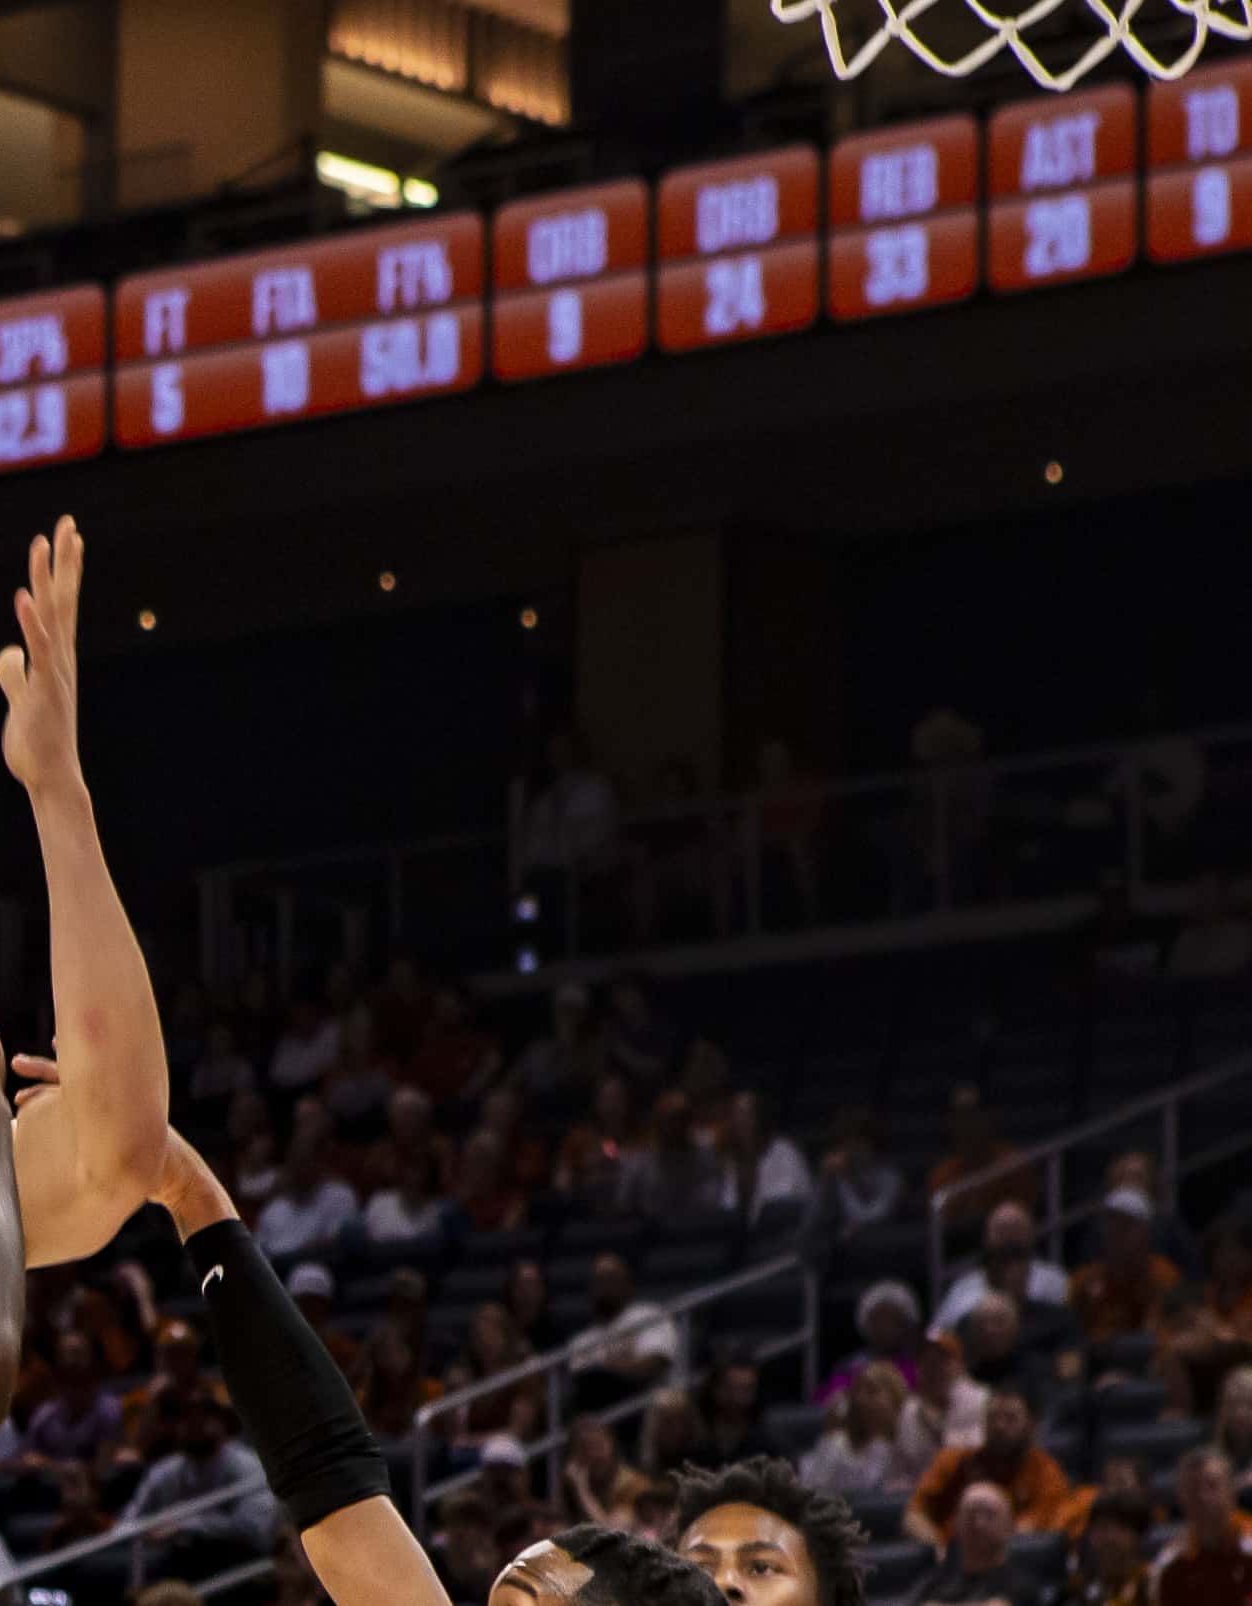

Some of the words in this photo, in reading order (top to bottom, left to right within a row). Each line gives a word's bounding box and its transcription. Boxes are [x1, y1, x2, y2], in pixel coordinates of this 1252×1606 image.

[1021, 112, 1098, 191] AST
[704, 254, 764, 335] 24
[866, 223, 929, 306] 33
[143, 286, 188, 357] FT
[252, 266, 317, 336] FTA
